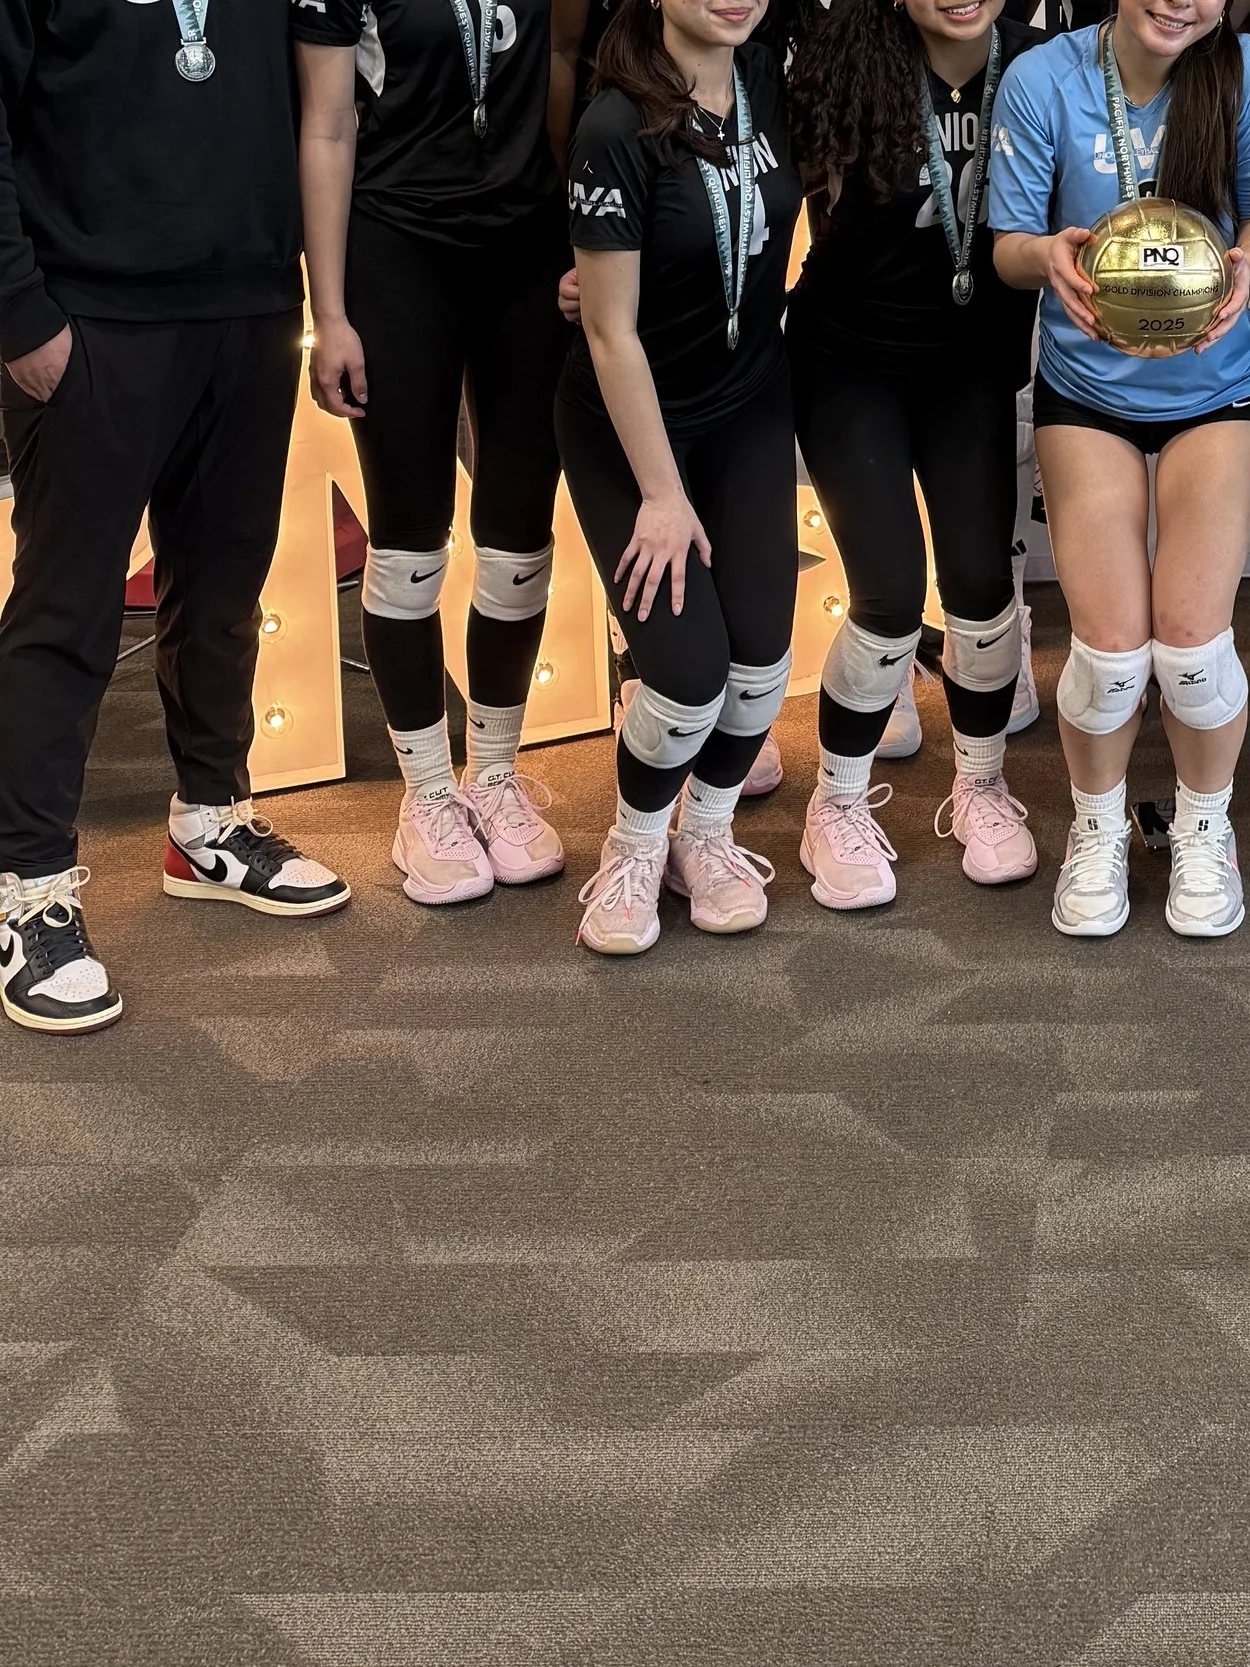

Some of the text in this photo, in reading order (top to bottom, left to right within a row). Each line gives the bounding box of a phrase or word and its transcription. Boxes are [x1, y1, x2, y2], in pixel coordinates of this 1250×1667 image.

[484, 6, 494, 48] PACIFIC
[1112, 96, 1126, 137] PACIFIC
[708, 176, 726, 234] QUALIFIER
[966, 184, 980, 253] NORTHWEST
[975, 128, 990, 182] QUALIFIER
[1143, 247, 1180, 267] PNQ
[1104, 285, 1219, 298] GOLD DIVISION CHAMPIONS
[1138, 317, 1186, 332] 2025
[429, 786, 449, 799] CUT
